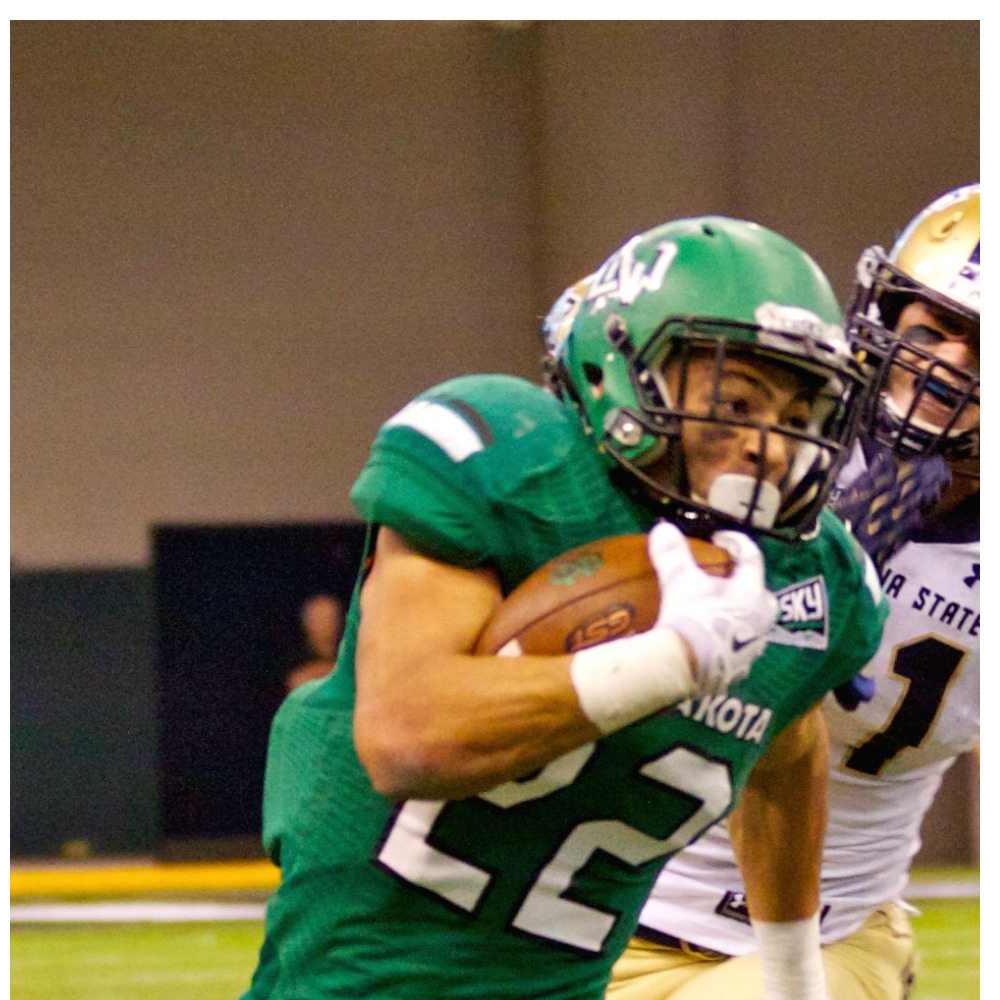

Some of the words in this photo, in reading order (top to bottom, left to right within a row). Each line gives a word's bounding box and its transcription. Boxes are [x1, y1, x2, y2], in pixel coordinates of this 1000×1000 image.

[779, 581, 824, 622] SKY
[912, 586, 980, 636] STATE
[837, 632, 971, 777] 1
[376, 742, 733, 954] 22
